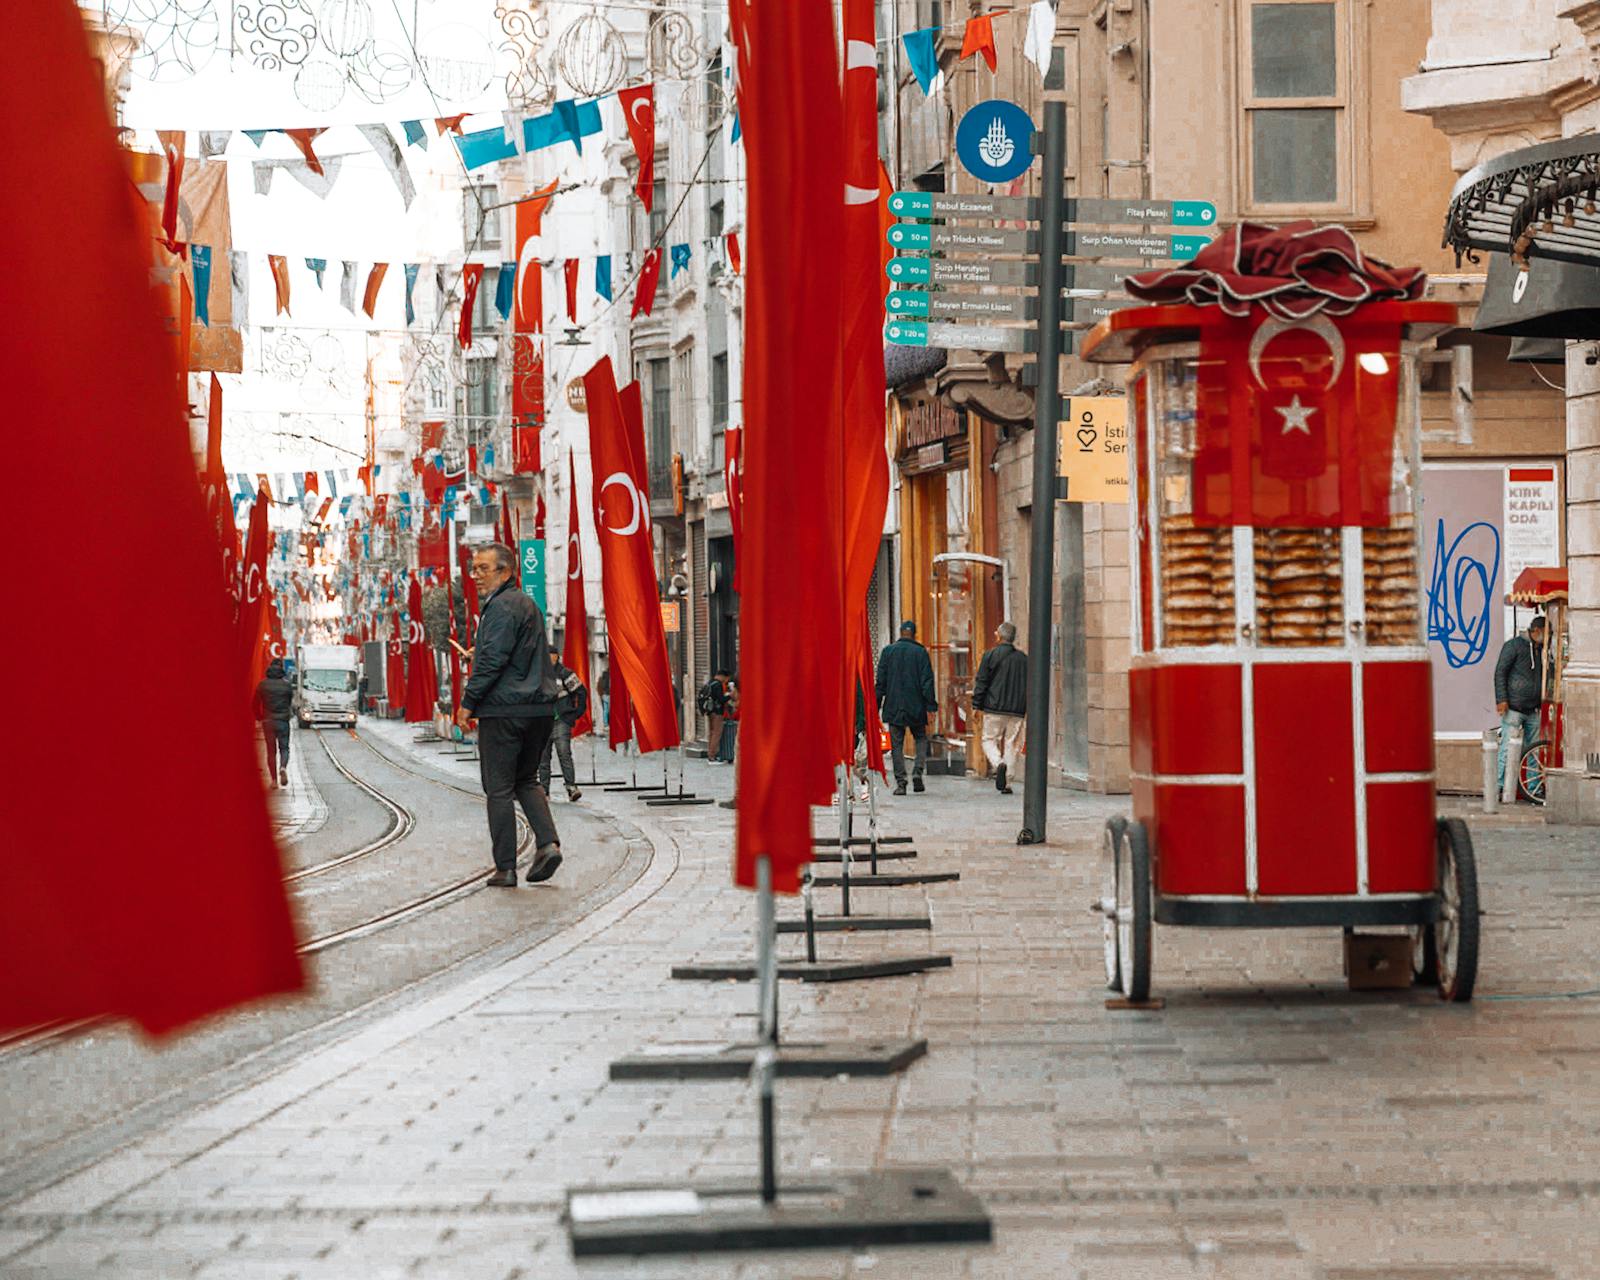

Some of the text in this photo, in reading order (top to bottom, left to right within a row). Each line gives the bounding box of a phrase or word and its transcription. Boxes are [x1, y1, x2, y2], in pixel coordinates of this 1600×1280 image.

[936, 201, 958, 210] Rebul
[1082, 236, 1100, 245] Surp
[910, 266, 919, 274] 90
[935, 264, 953, 273] Surp
[905, 300, 918, 308] 120
[1509, 514, 1538, 524] ODA
